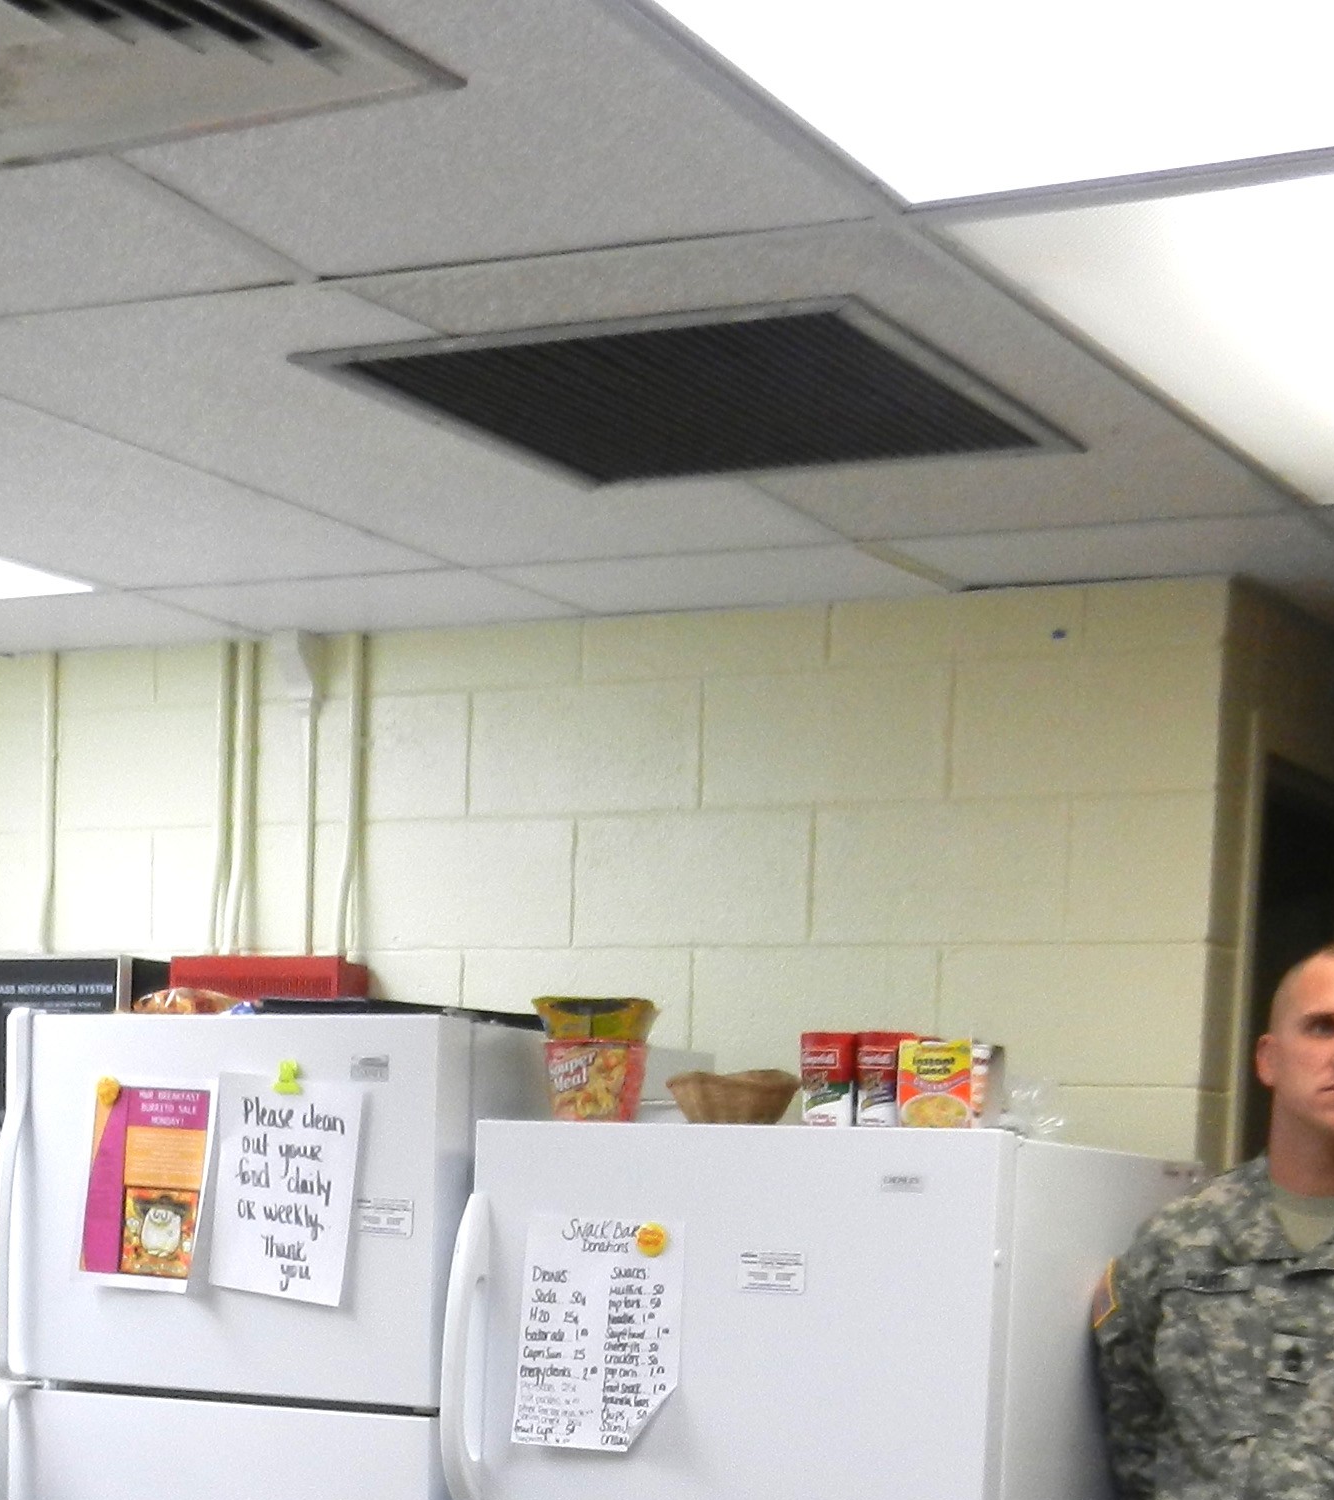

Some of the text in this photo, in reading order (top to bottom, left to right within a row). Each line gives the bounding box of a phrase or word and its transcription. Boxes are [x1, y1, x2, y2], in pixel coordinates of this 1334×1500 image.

[17, 984, 77, 994] NOTIFICATION
[78, 984, 113, 994] SYSTEM
[140, 1102, 196, 1115] BURRITO SALE
[242, 1096, 345, 1135] Please clean
[242, 1133, 269, 1156] out
[235, 1157, 270, 1189] food
[288, 1166, 332, 1207] daily
[261, 1234, 307, 1262] Thank
[582, 1239, 629, 1253] Donations
[279, 1263, 311, 1291] you
[531, 1288, 557, 1304] Soda
